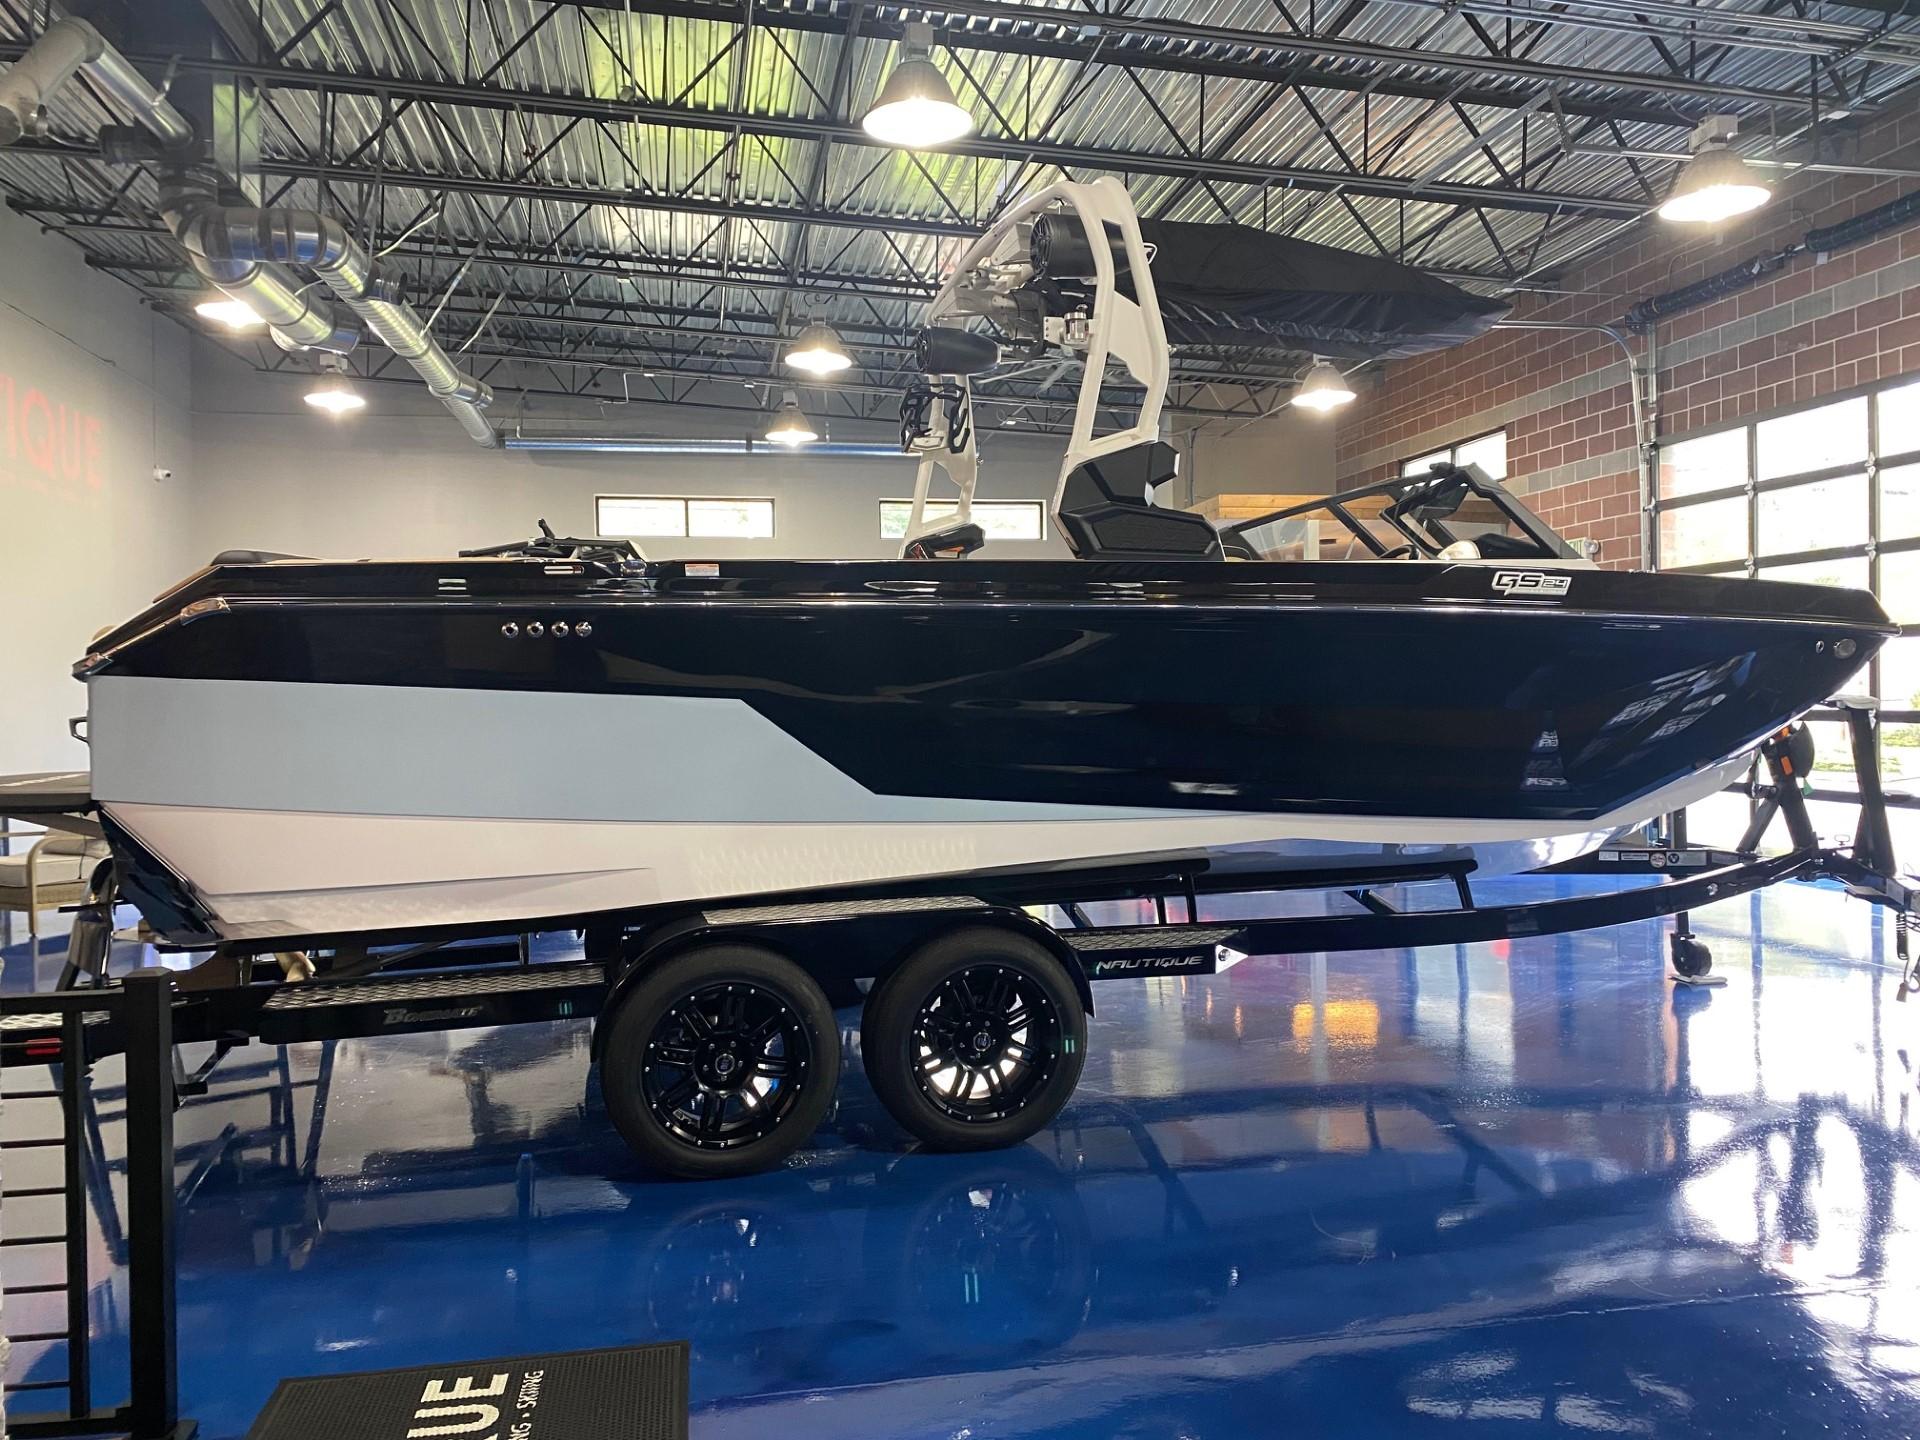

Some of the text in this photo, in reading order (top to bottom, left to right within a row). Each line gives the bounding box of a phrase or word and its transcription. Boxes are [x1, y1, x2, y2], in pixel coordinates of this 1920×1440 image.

[1096, 956, 1204, 972] NAUTIQUE
[406, 1373, 509, 1440] UE
[516, 1370, 544, 1409] SKIING
